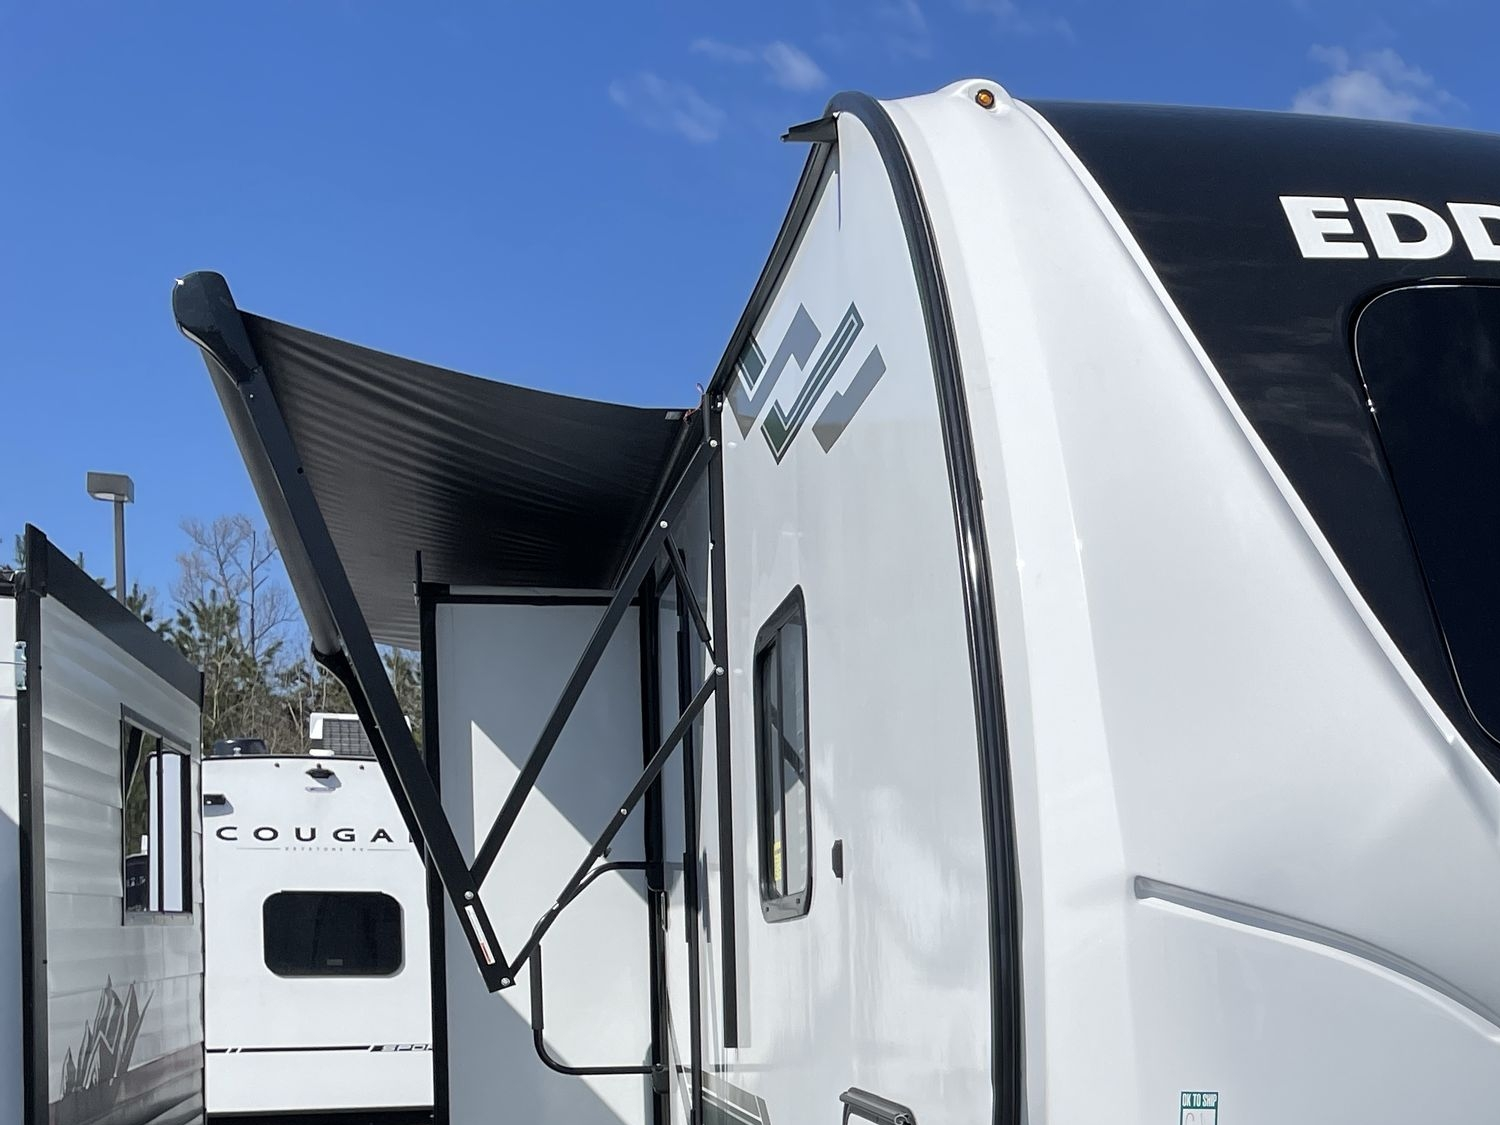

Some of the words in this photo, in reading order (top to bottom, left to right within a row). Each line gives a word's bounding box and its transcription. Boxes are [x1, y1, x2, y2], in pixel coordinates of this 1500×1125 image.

[215, 826, 414, 843] COUGA
[1182, 1093, 1191, 1107] OK
[1193, 1093, 1201, 1107] TO
[1202, 1093, 1217, 1107] SHIP
